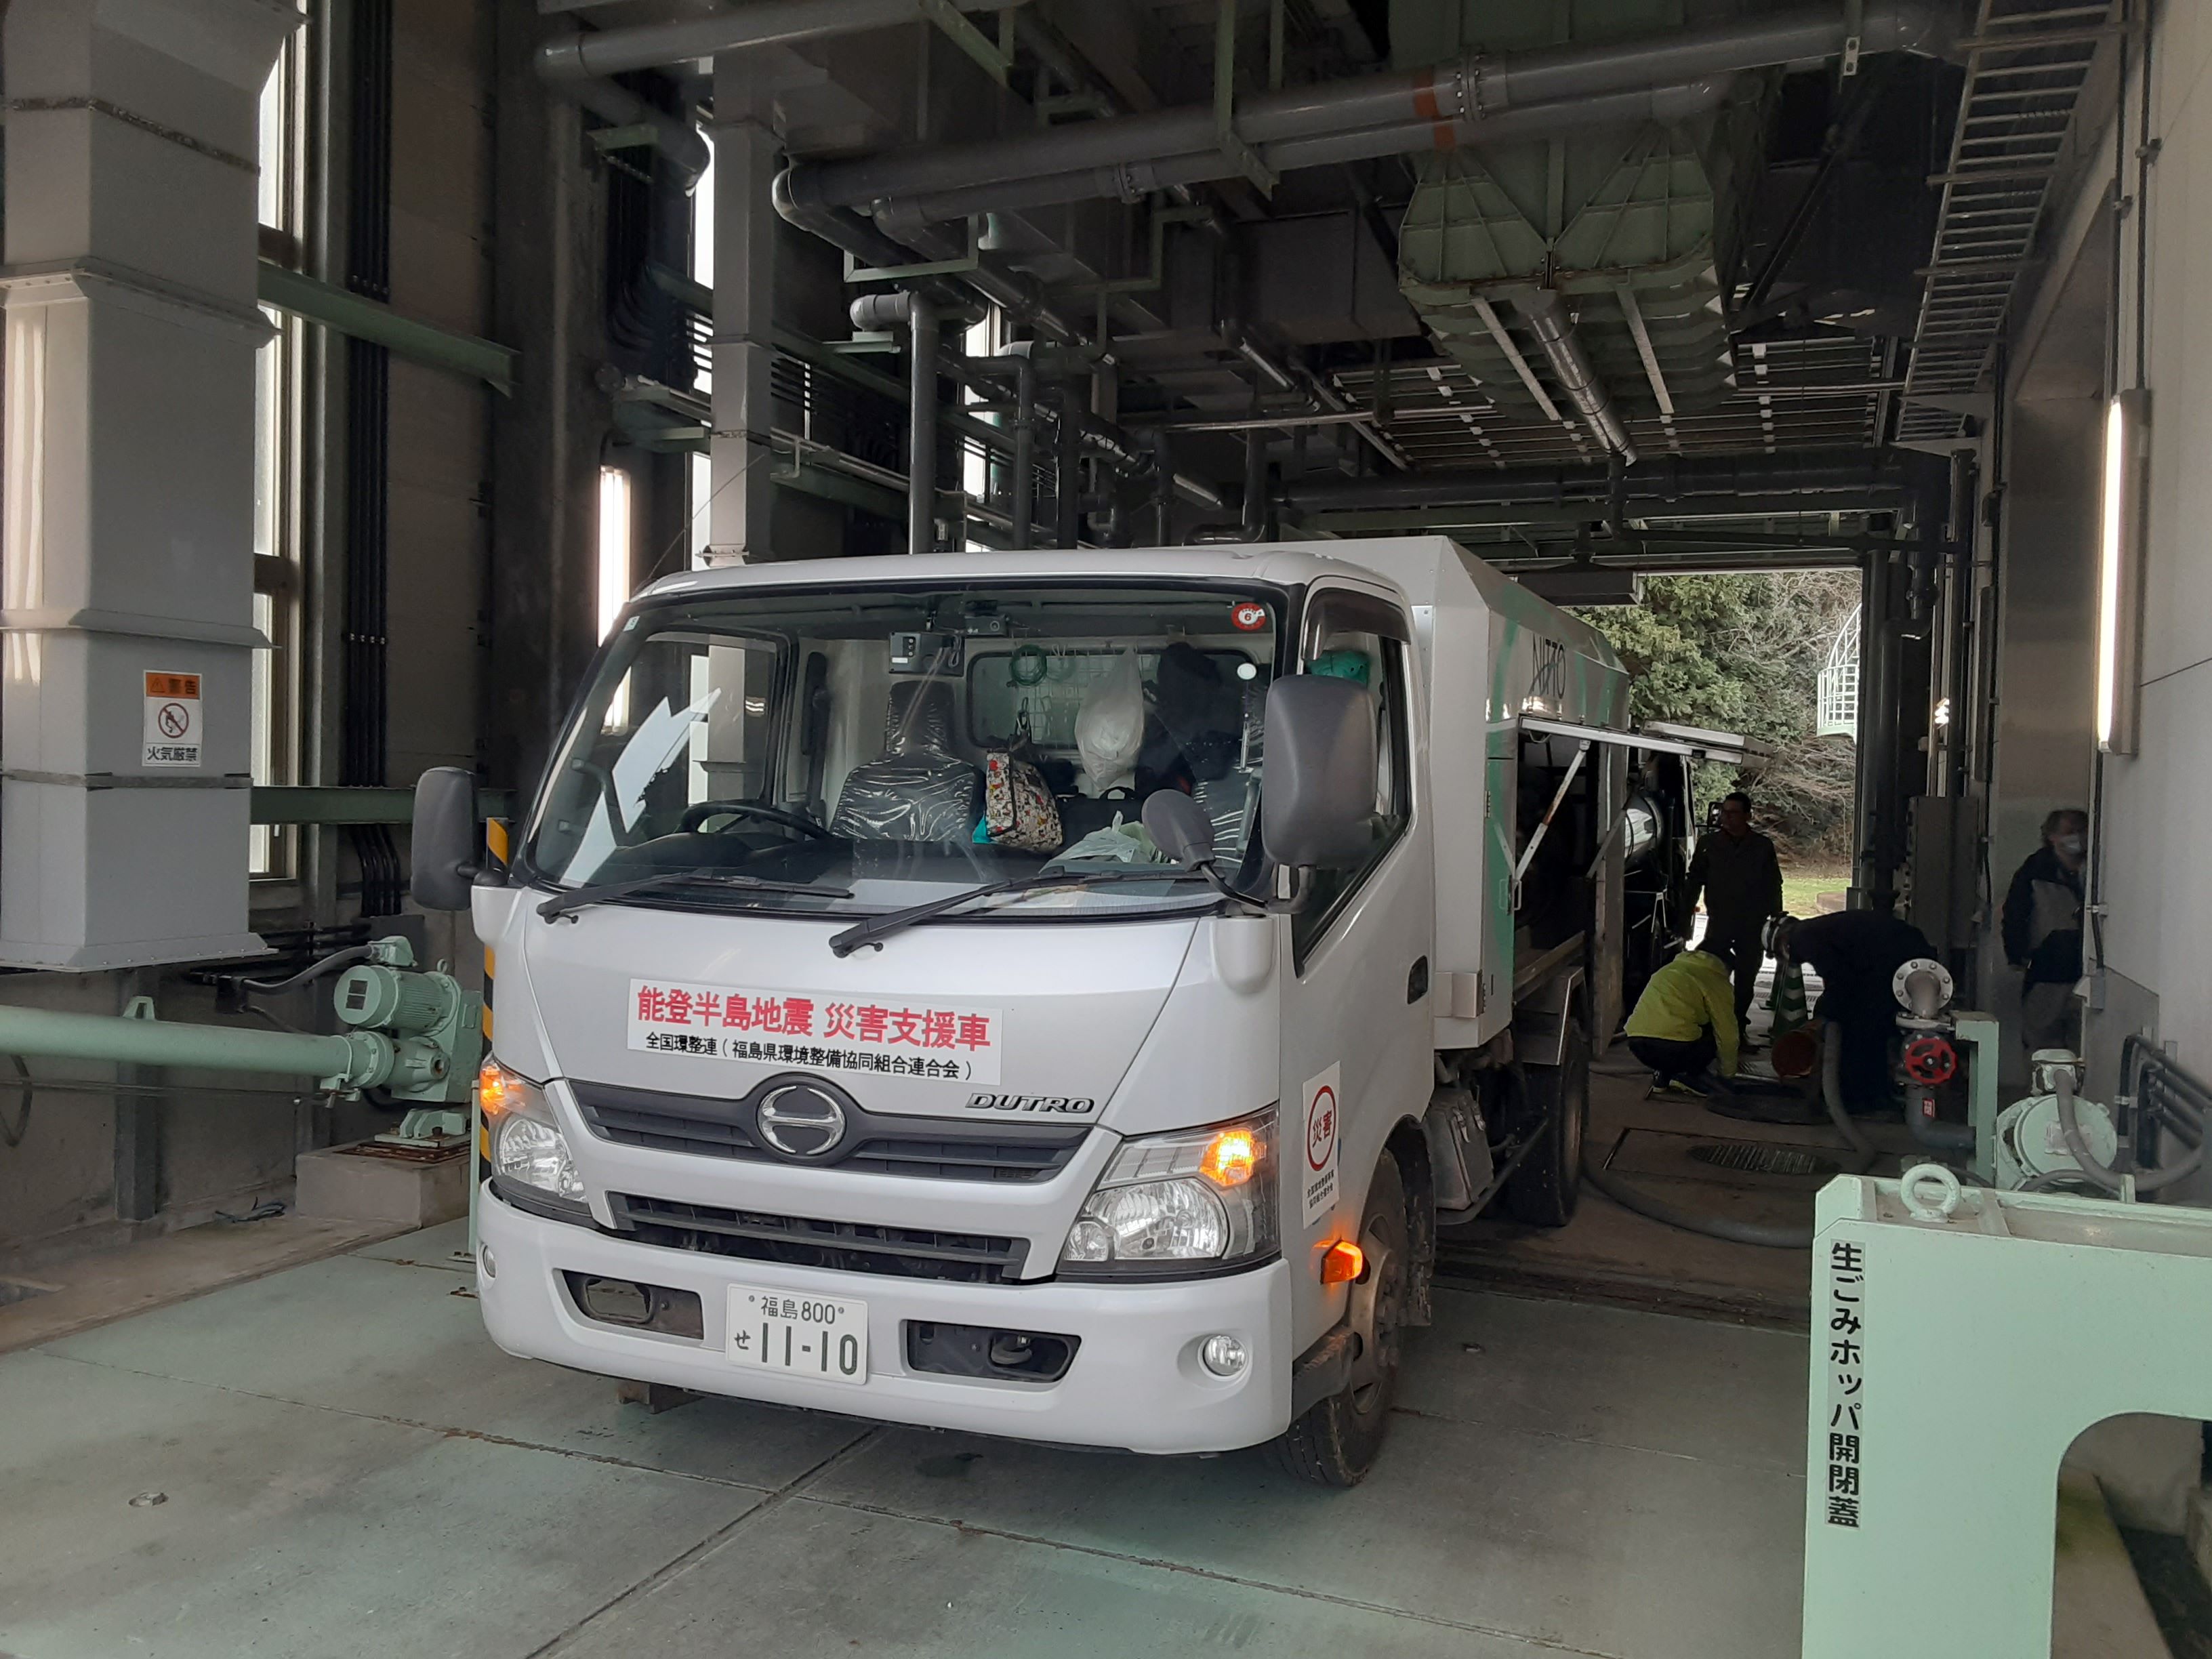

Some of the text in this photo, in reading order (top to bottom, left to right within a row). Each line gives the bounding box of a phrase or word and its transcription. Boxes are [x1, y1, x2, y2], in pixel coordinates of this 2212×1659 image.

[147, 746, 198, 762] 火気厳禁
[637, 985, 991, 1052] 能登半島地震 災害支援車
[965, 1092, 1094, 1113] DUTRO
[1312, 1109, 1333, 1148] 災害
[761, 1322, 858, 1376] 11-10
[1828, 1242, 1864, 1528] 生ごみホッパ開閉蓋
